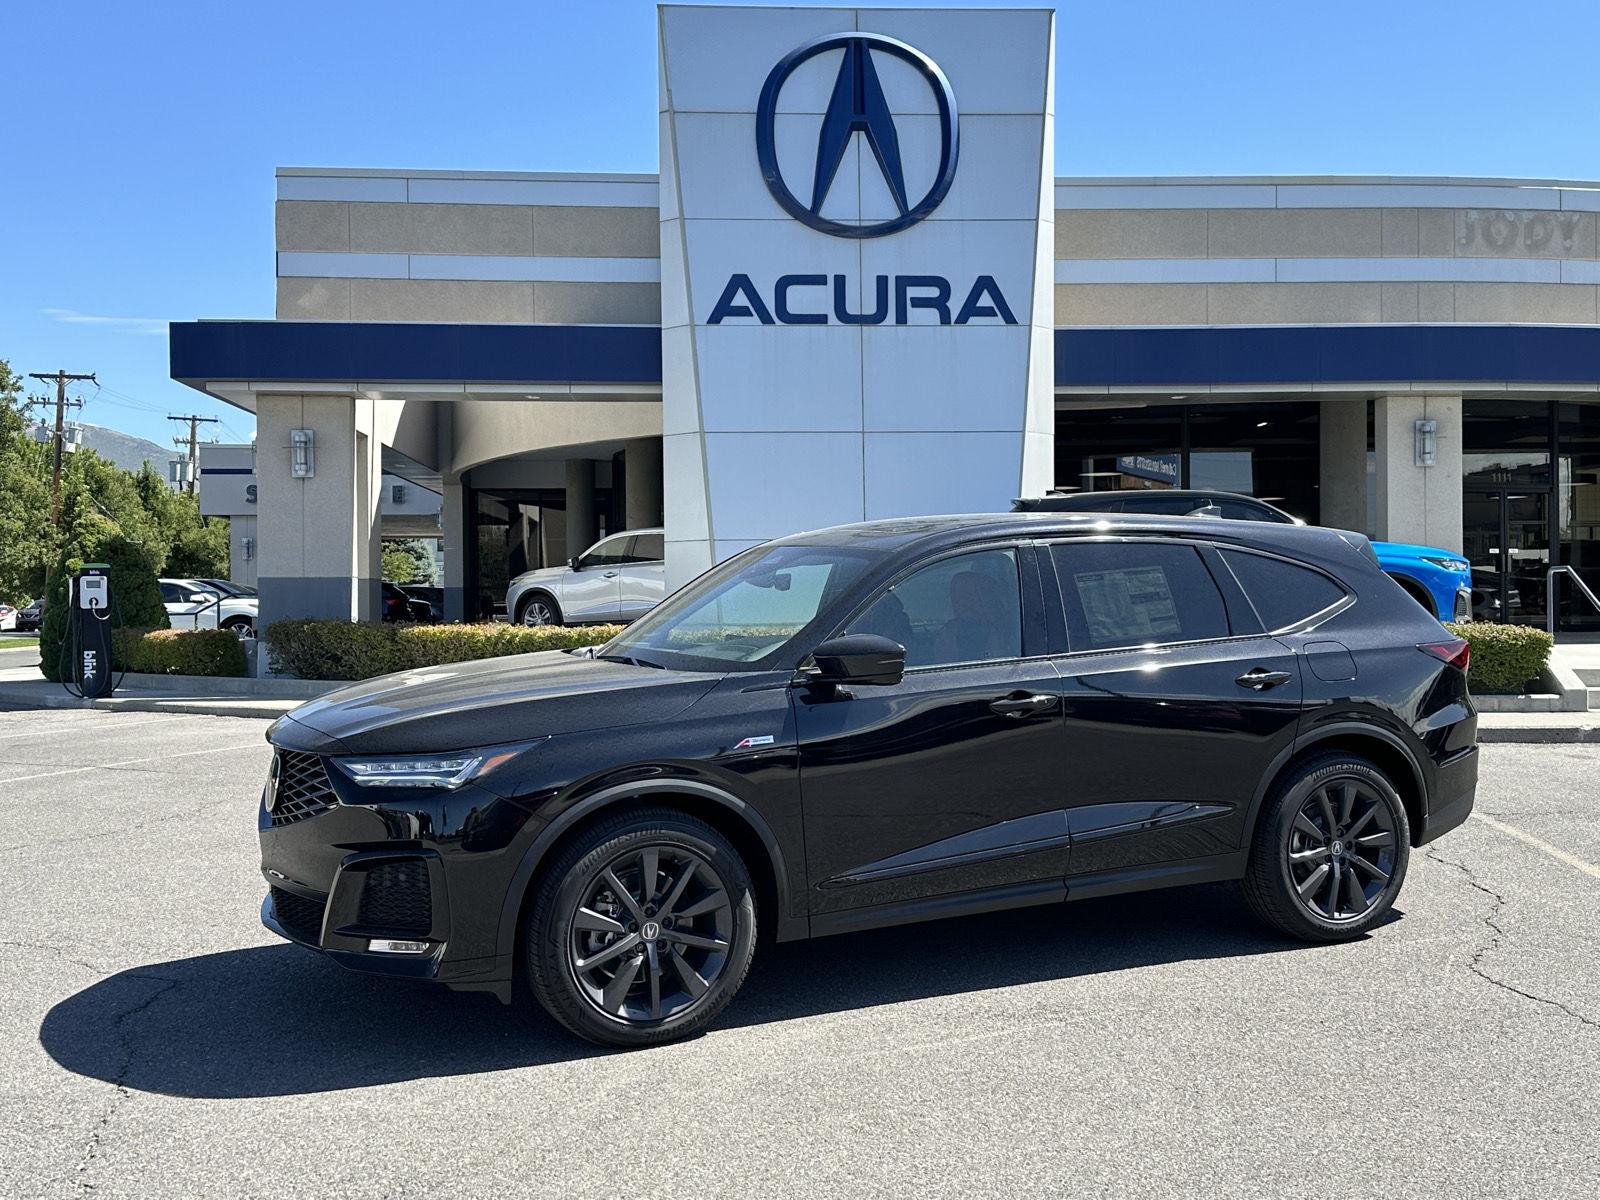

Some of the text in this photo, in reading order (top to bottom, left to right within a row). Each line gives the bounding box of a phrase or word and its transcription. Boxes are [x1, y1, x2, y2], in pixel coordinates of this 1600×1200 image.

[706, 274, 1019, 325] ACURA
[1491, 472, 1512, 483] 1111
[83, 650, 97, 679] blink
